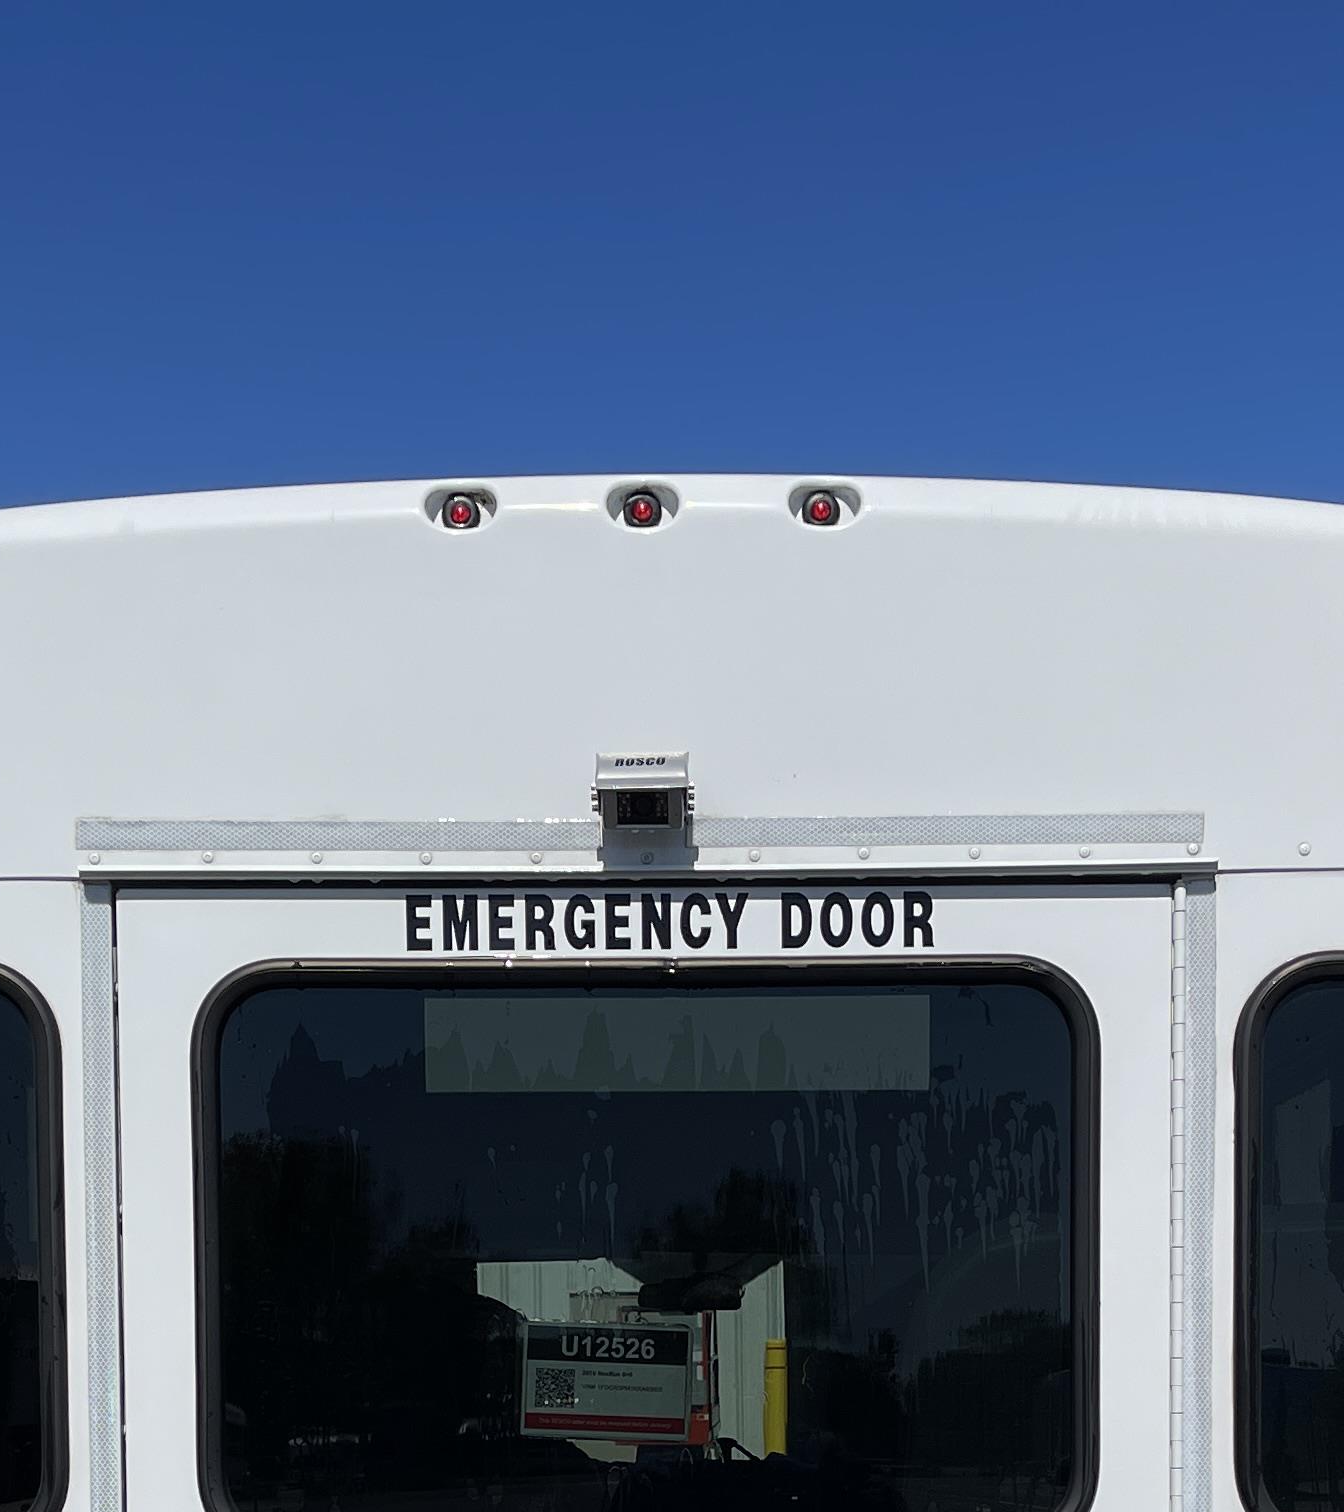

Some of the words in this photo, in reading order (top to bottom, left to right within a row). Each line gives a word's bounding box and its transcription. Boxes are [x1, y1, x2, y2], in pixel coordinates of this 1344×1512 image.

[405, 892, 749, 952] EMERGENCY
[780, 890, 935, 949] DOOR
[561, 1335, 655, 1359] U12526
